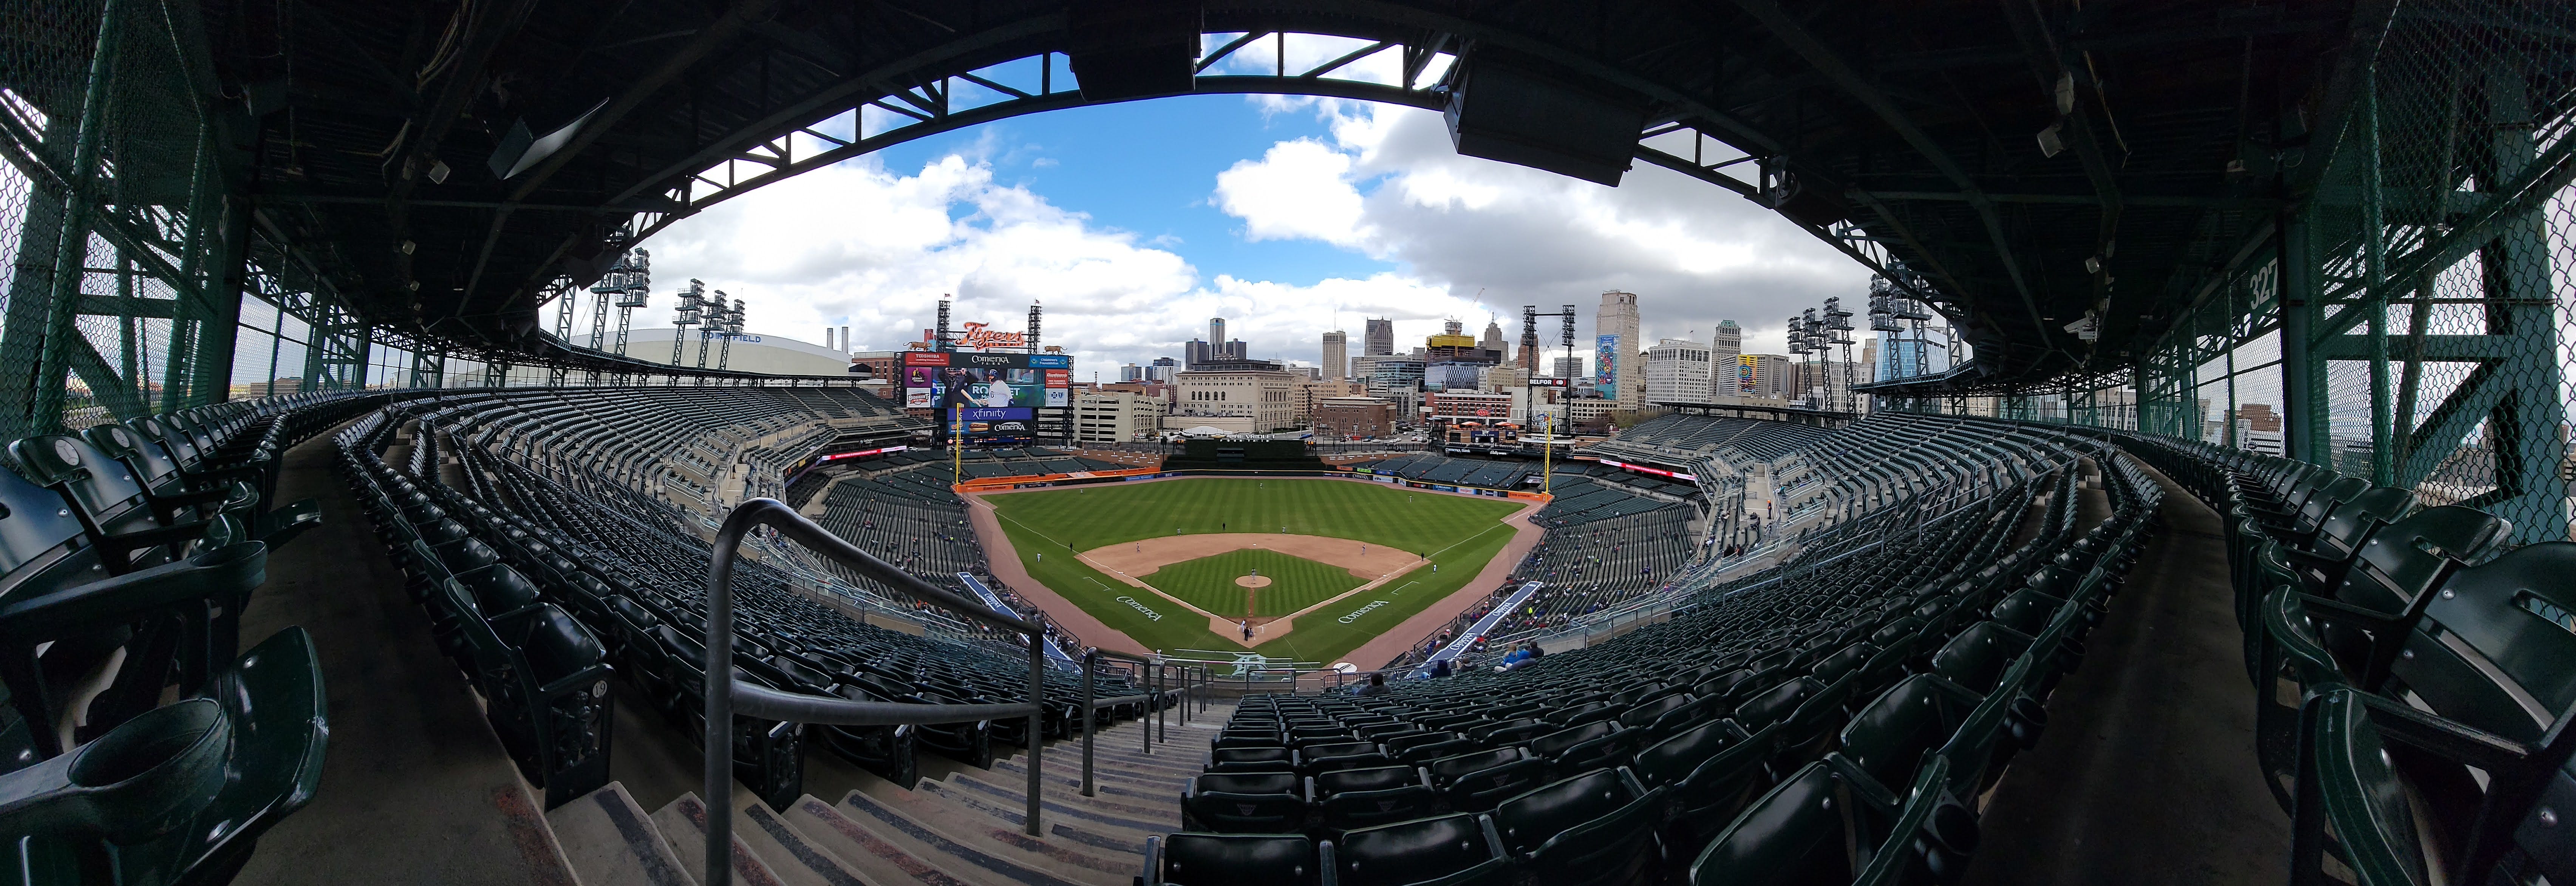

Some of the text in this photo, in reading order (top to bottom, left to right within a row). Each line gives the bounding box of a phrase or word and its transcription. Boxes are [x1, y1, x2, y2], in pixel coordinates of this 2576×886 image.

[2250, 258, 2278, 310] 327
[955, 322, 1025, 351] Tigers
[973, 408, 1006, 419] xfinity
[596, 683, 606, 695] 19
